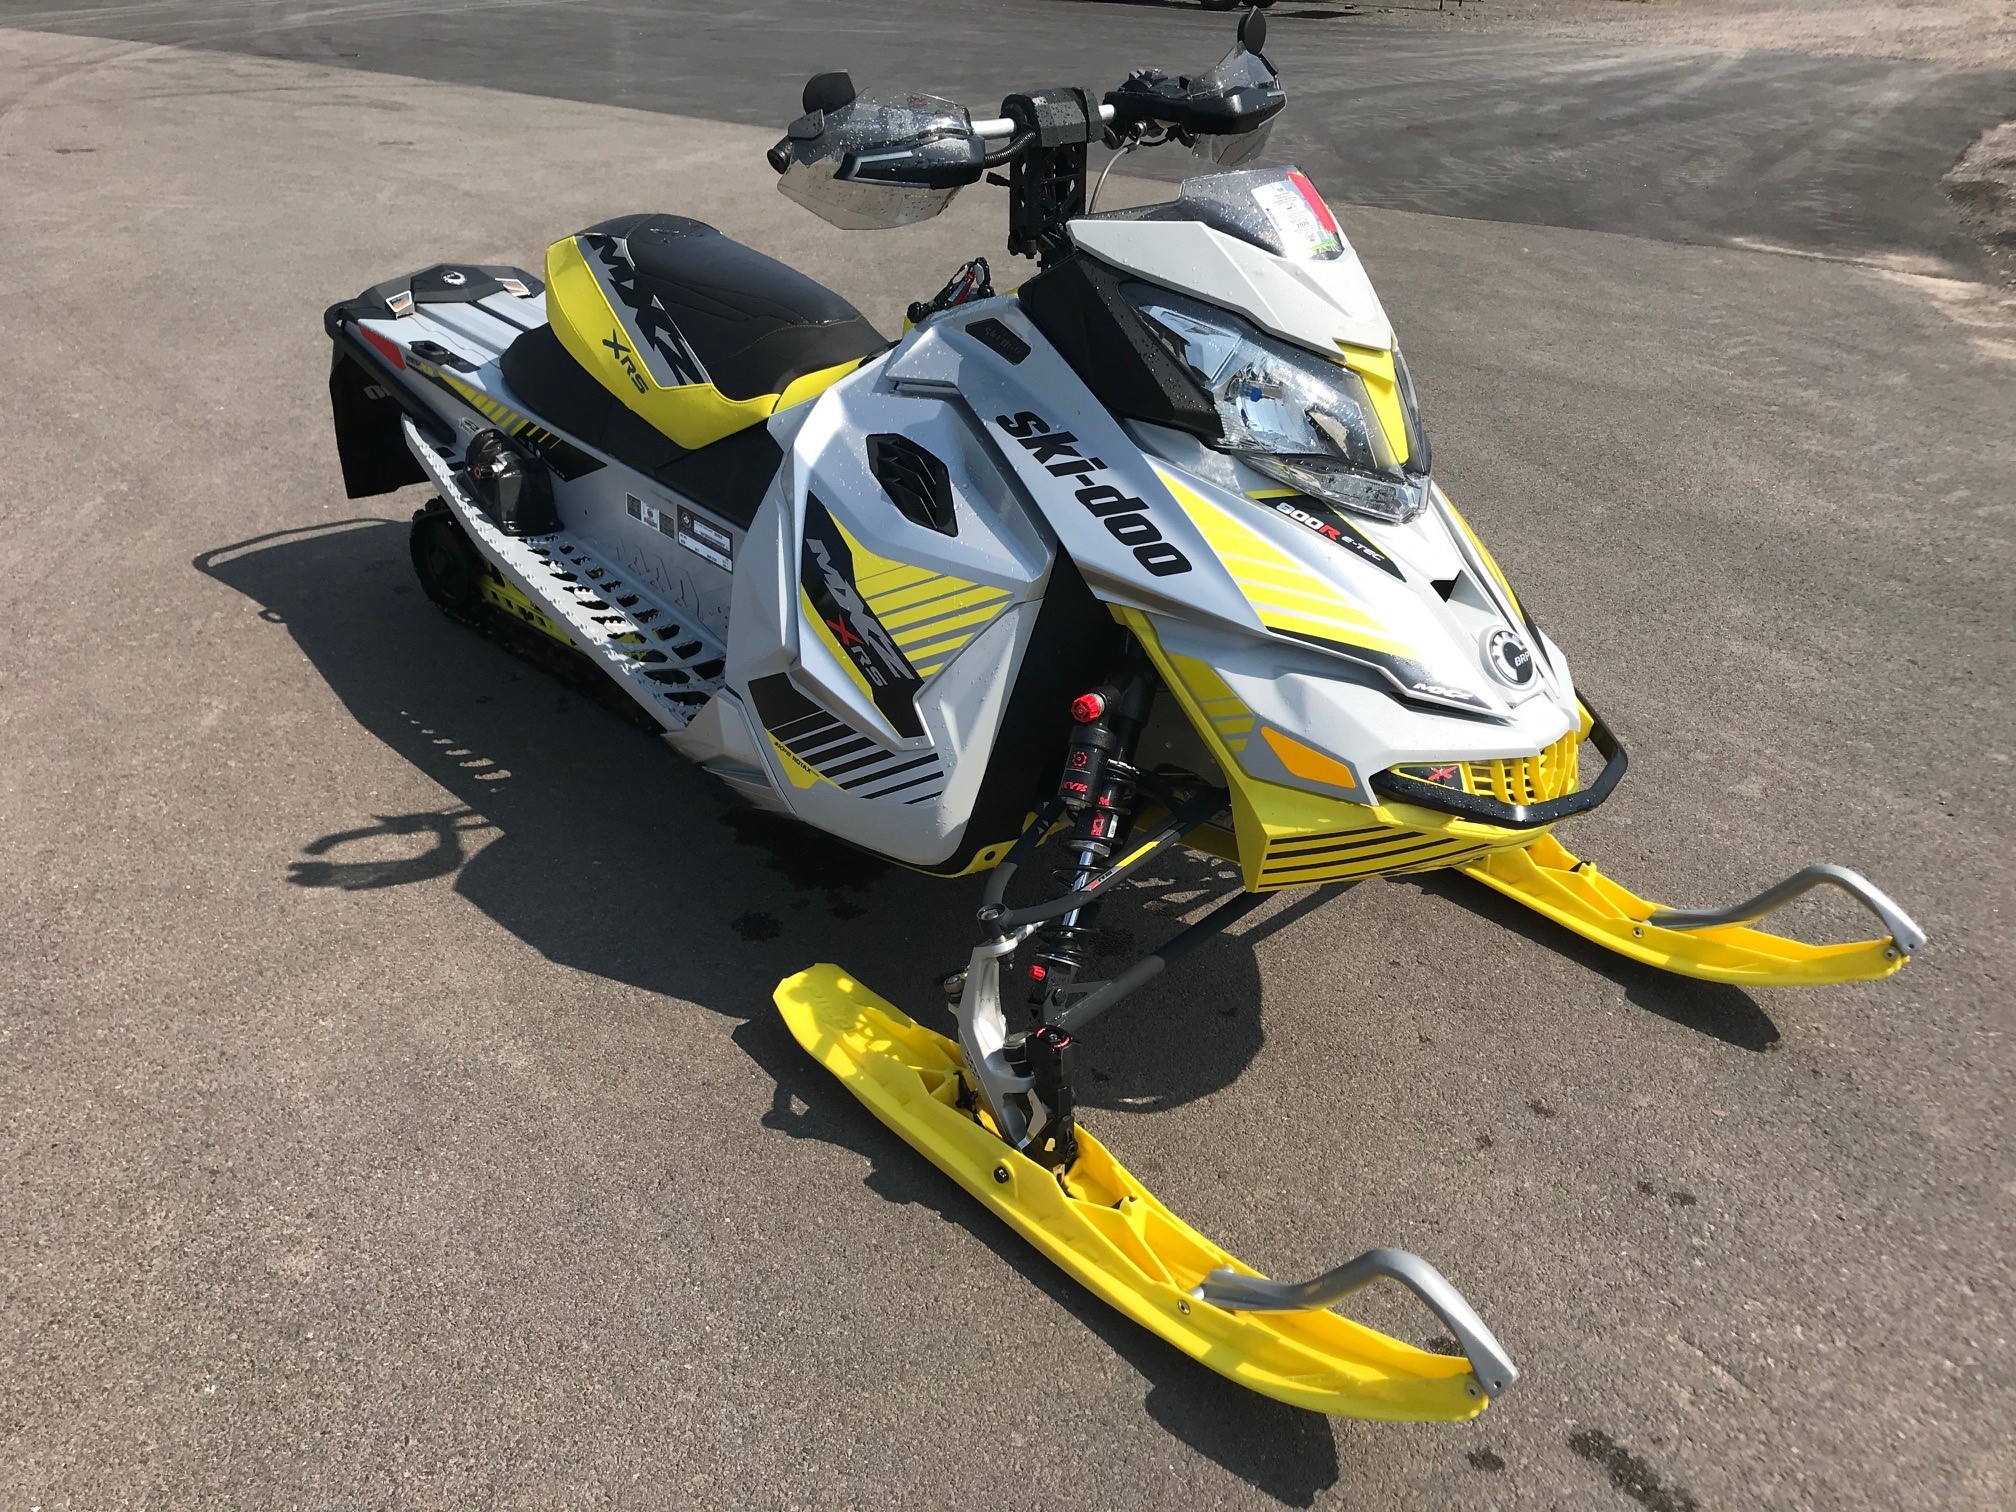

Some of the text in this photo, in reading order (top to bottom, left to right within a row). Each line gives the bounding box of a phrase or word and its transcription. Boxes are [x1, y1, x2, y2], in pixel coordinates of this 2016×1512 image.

[602, 329, 649, 394] XRS
[995, 411, 1193, 577] ski-doo
[1276, 502, 1385, 562] 800R E-TEC
[806, 538, 915, 680] MXZ
[826, 613, 889, 687] XRS
[1514, 651, 1530, 667] BRP
[792, 755, 811, 774] ROTAX
